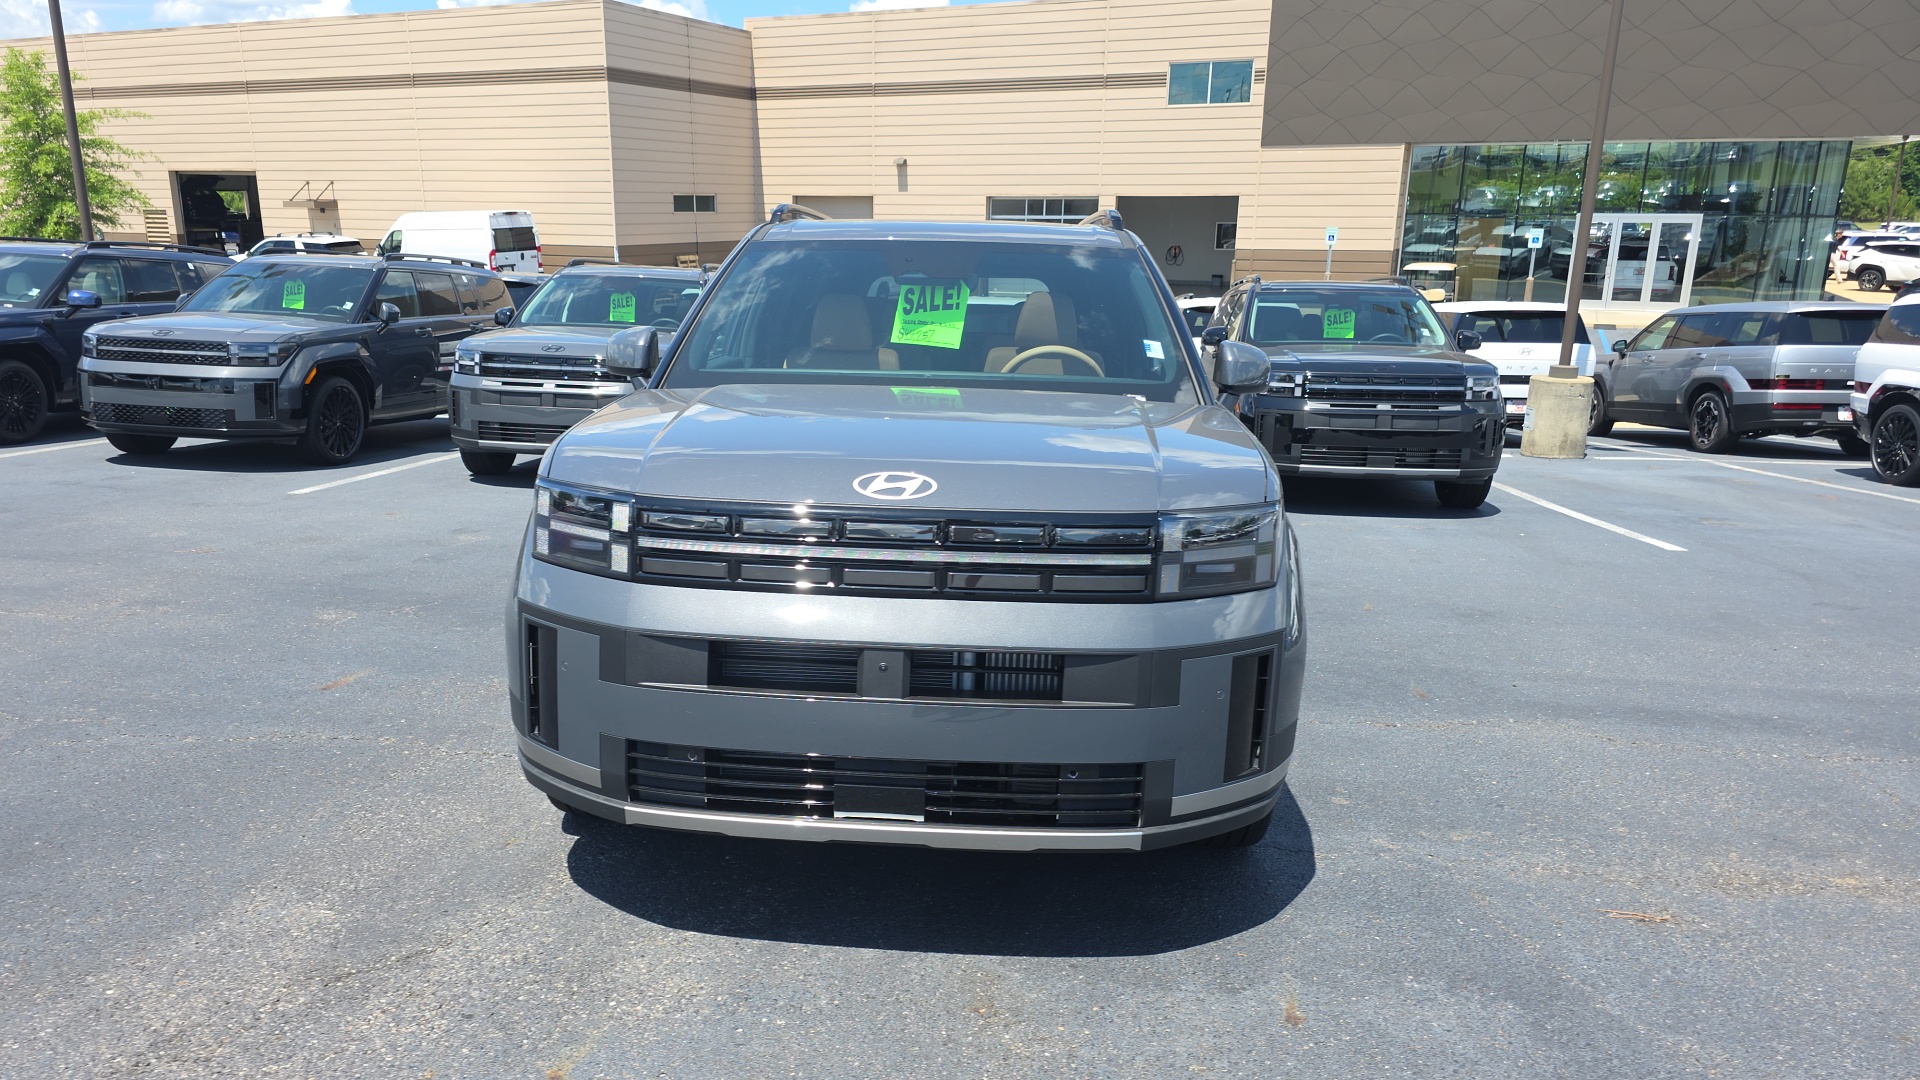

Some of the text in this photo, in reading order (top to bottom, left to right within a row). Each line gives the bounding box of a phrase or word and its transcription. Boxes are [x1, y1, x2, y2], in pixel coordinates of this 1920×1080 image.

[285, 283, 303, 297] SALE!
[611, 295, 633, 310] SALE!
[902, 283, 962, 316] SALE!
[1326, 310, 1352, 327] SALE!
